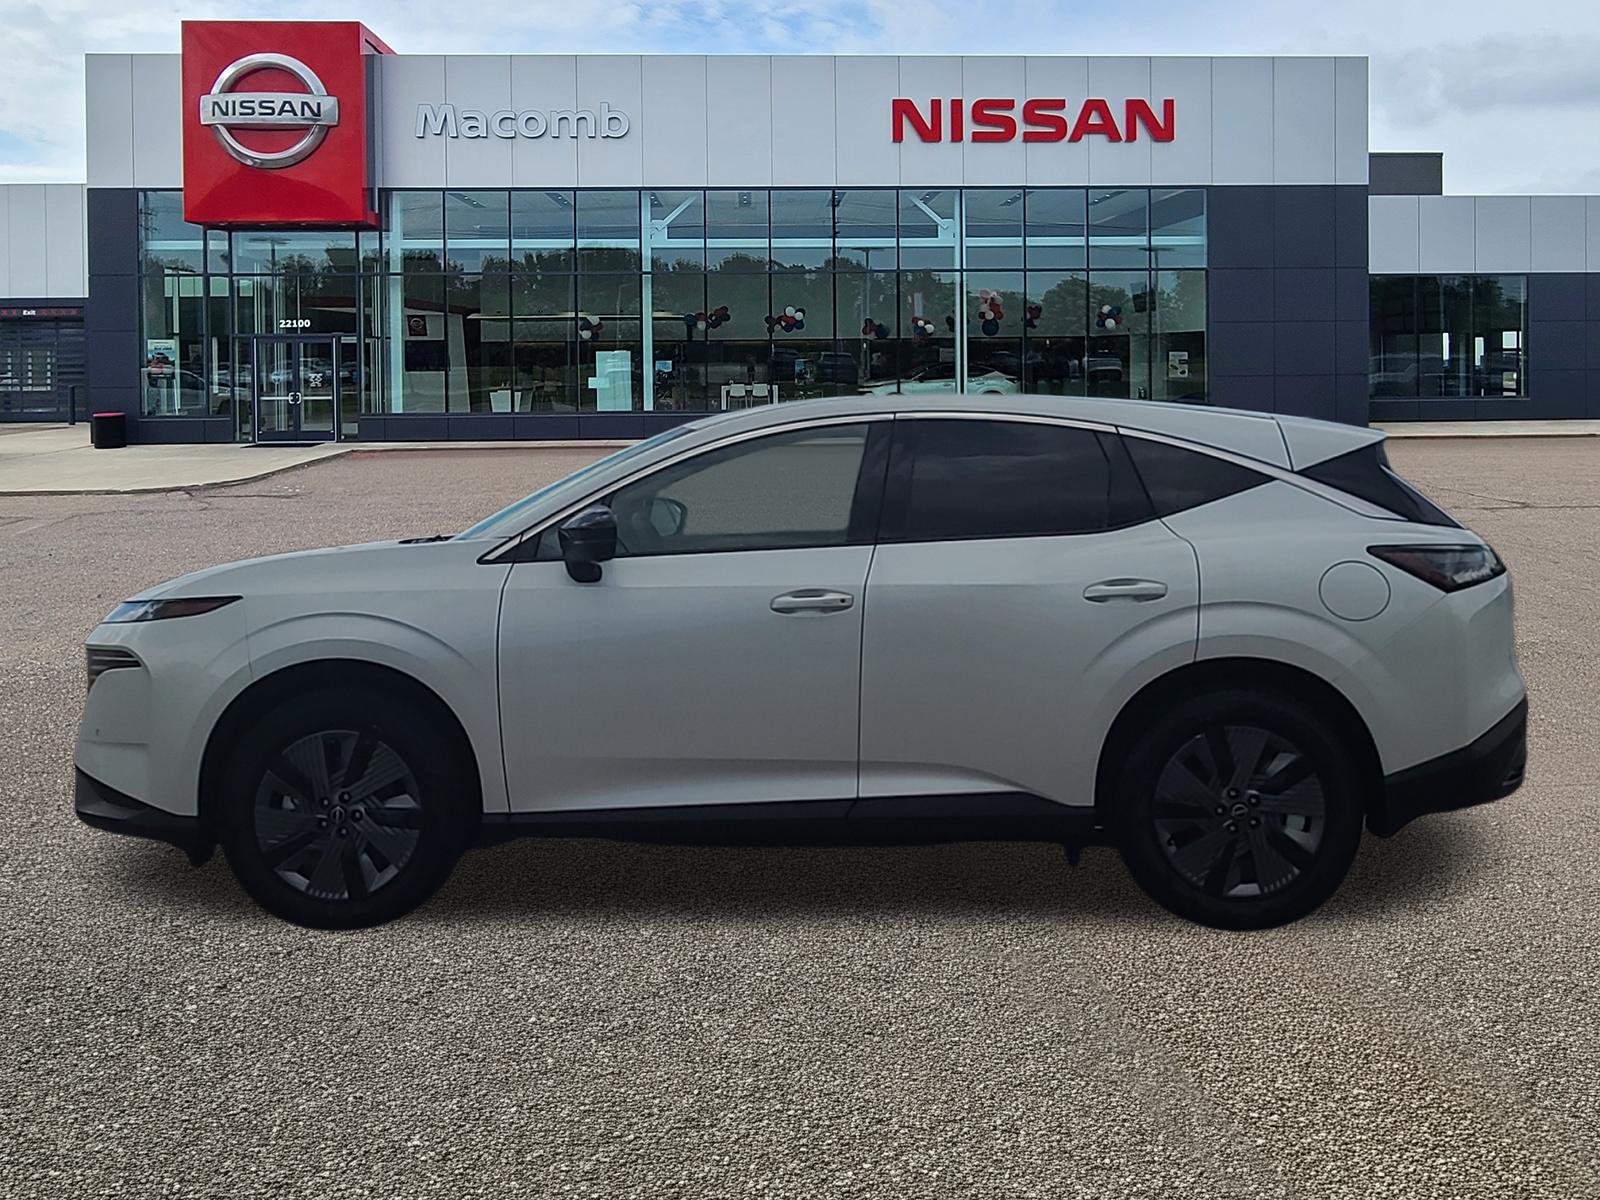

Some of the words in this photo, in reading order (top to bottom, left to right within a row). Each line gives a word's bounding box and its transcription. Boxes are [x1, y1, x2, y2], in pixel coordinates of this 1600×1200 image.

[211, 99, 322, 118] NISSAN
[414, 102, 631, 139] Macomb
[891, 98, 1175, 143] NISSAN
[279, 319, 311, 328] 22100
